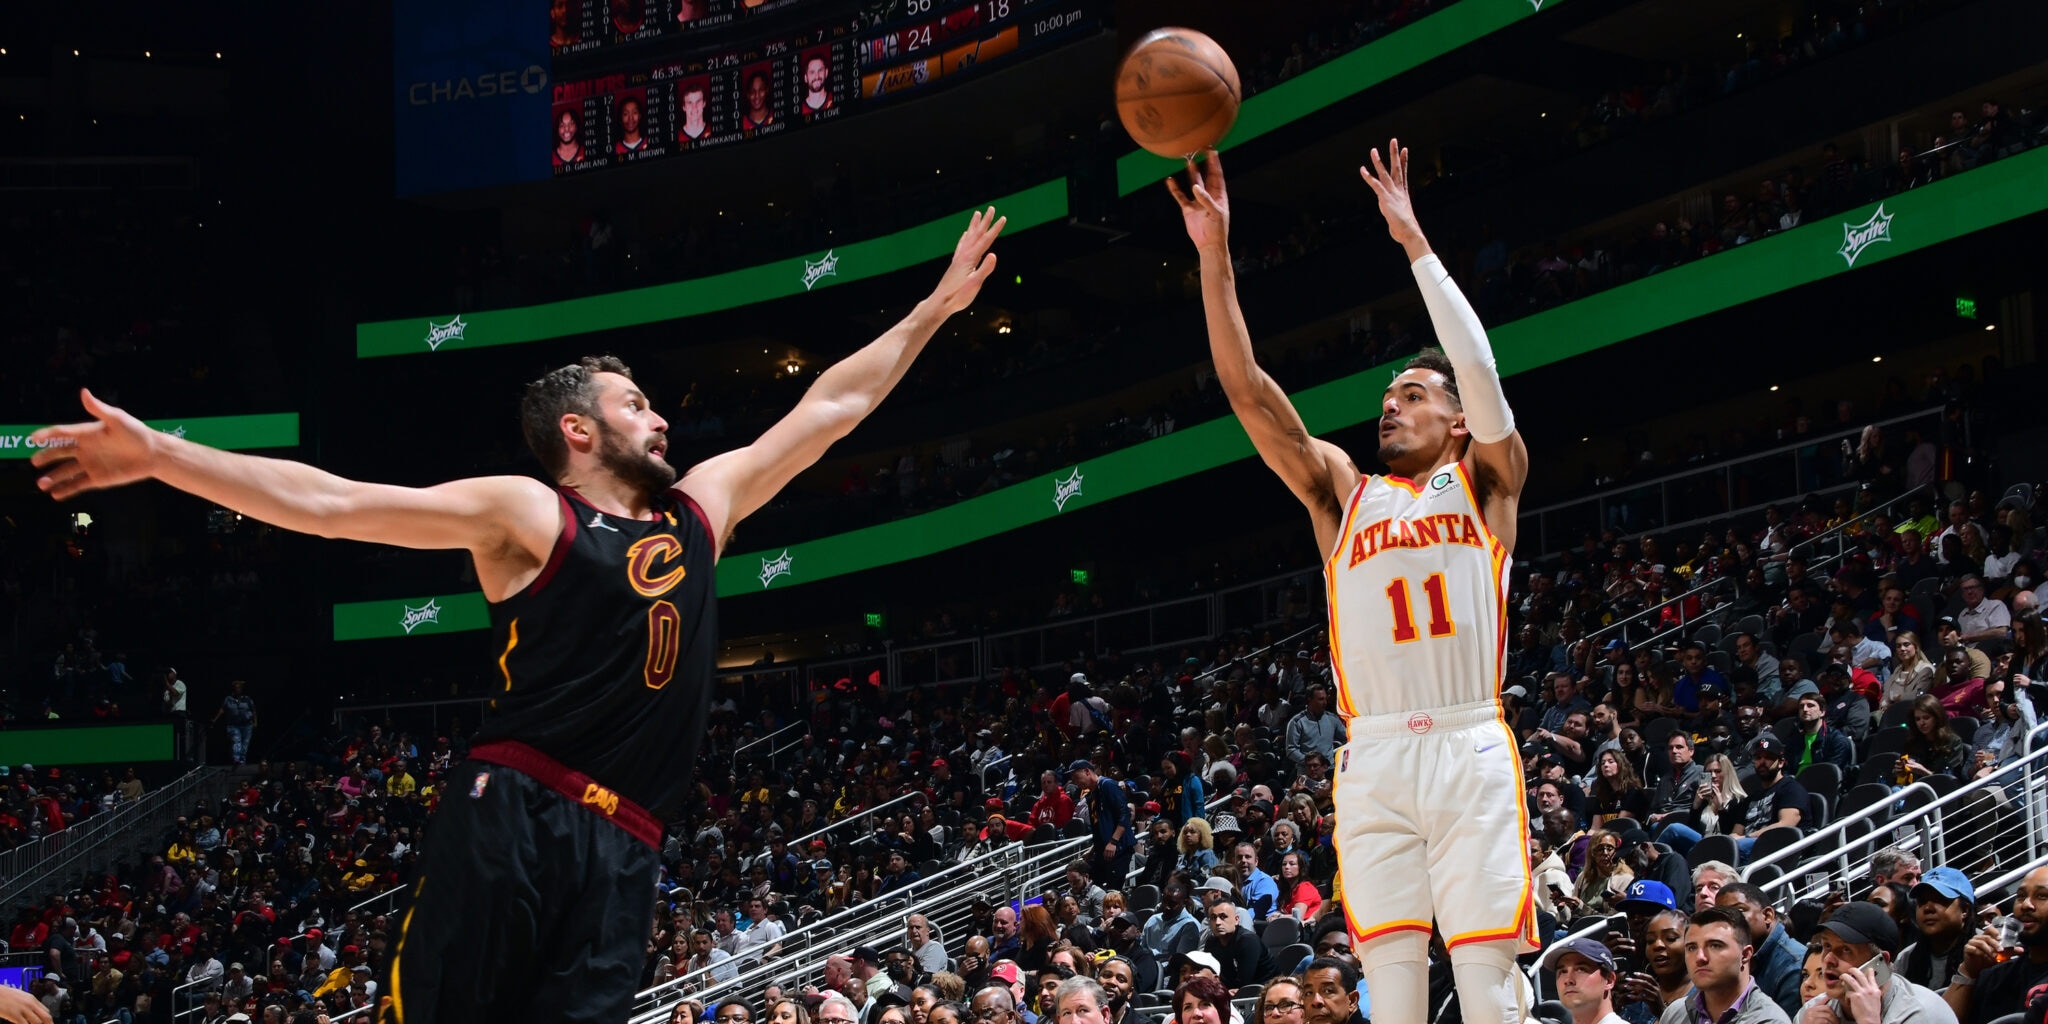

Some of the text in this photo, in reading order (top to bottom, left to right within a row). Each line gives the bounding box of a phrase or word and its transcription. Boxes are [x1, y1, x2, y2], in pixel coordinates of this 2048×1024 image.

[907, 0, 931, 15] 56
[988, 0, 1010, 22] 18
[1034, 9, 1082, 36] 10:00 pm
[907, 25, 933, 51] 24
[652, 65, 684, 80] 46.3%
[707, 54, 740, 71] 21.4%
[766, 42, 787, 57] 75%
[409, 70, 519, 107] CHASE
[700, 132, 743, 148] MARKKANEN
[574, 157, 608, 172] GARLAND
[638, 147, 665, 160] BROWN
[1844, 220, 1888, 252] Sprite
[804, 260, 834, 281] Sprite
[429, 325, 462, 342] Sprite
[1055, 479, 1080, 501] Sprite
[1348, 513, 1484, 571] ATLANTA
[626, 534, 686, 597] C
[762, 559, 789, 578] Sprite
[404, 608, 436, 625] Sprite
[1385, 572, 1456, 644] 11
[644, 600, 680, 689] 0
[1407, 718, 1433, 729] HAWKS
[583, 783, 619, 816] CAVS
[1631, 882, 1645, 896] KC
